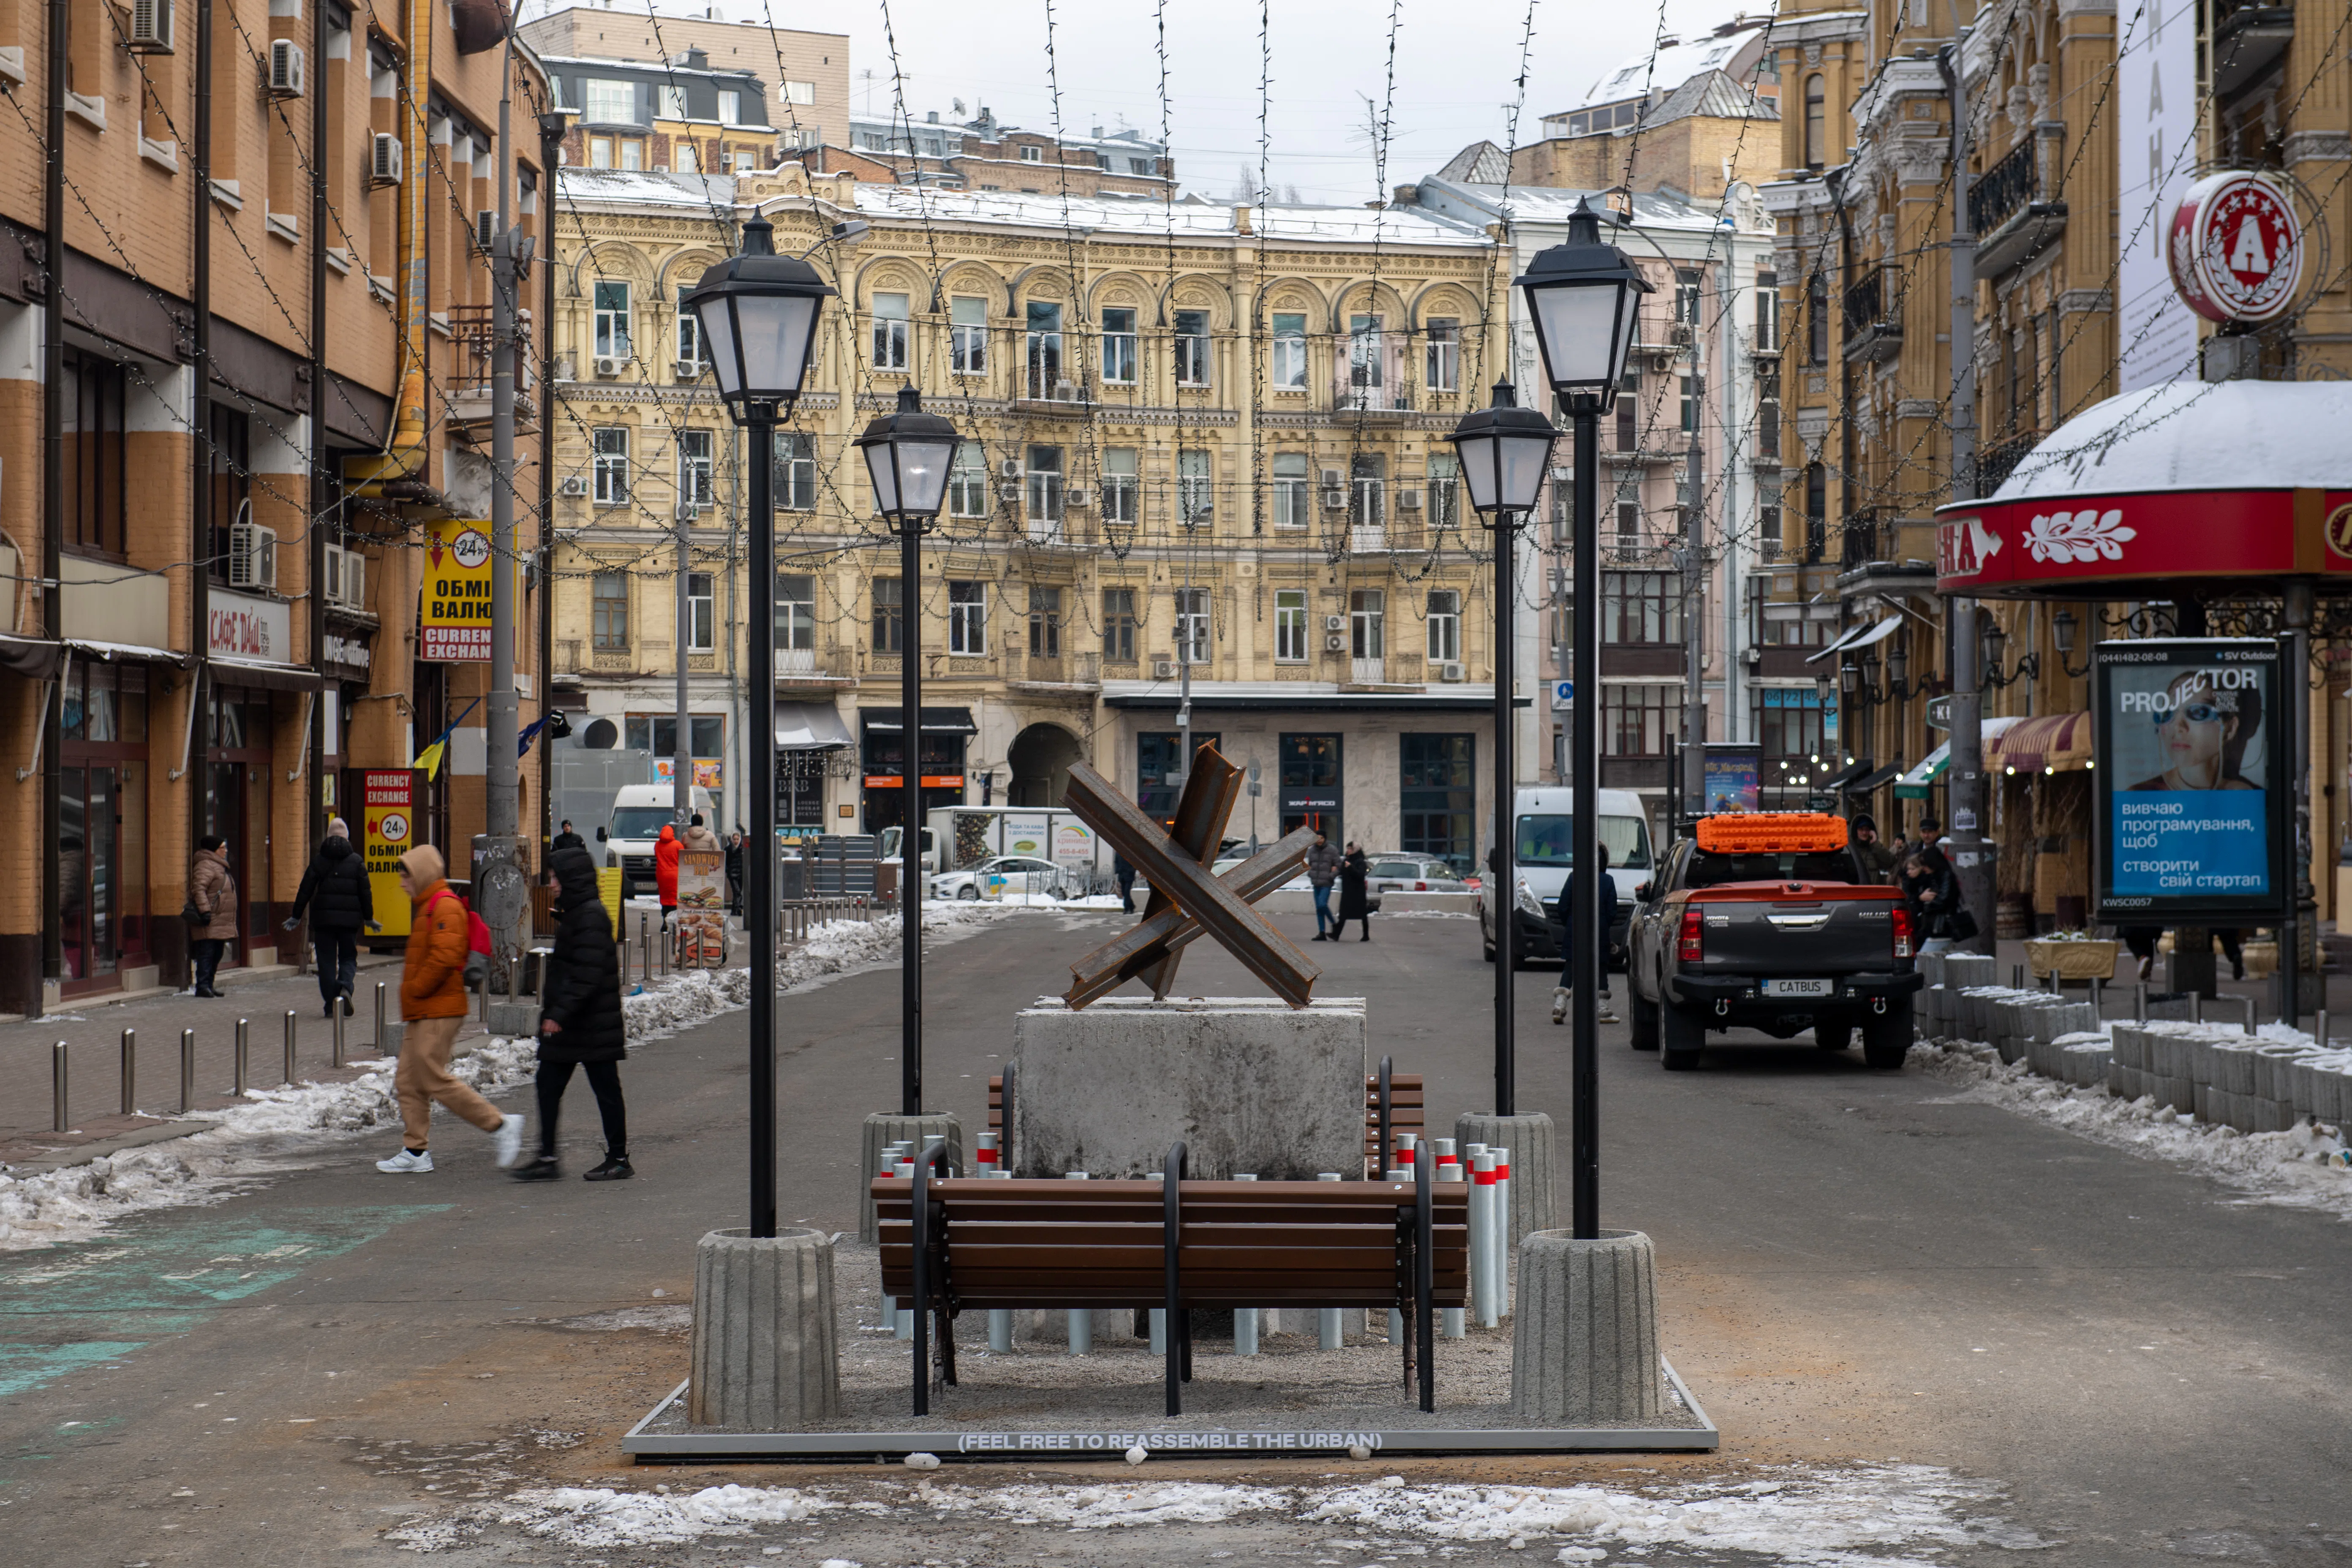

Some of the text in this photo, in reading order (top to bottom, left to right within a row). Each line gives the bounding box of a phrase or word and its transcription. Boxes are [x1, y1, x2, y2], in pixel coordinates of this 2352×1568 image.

[436, 580, 490, 597] ОБМІ
[432, 602, 492, 619] ВАЛЮ
[425, 629, 491, 642] CURREN
[427, 644, 491, 658] EXCHAN
[2240, 651, 2277, 660] Outdoor
[2121, 669, 2257, 713] PROJECTOR
[367, 775, 409, 787] CURRENCY
[368, 791, 408, 803] EXCHANGE
[2122, 803, 2183, 815] вивчаю
[385, 820, 403, 833] 24h
[2122, 819, 2255, 834] програмування,
[2122, 833, 2158, 850] щоб
[369, 845, 407, 856] ОБМІН
[684, 853, 720, 865] SANDWICH
[368, 862, 401, 873] ВАЛЮ
[693, 866, 709, 876] BAR
[2123, 860, 2200, 875] створити
[2159, 872, 2261, 889] свій стартап
[2102, 897, 2152, 907] KWSC0057
[1779, 981, 1821, 992] CATBUS
[958, 1433, 1383, 1453] (FEEL FREE TO REASSEMBLE THE URBAN)
